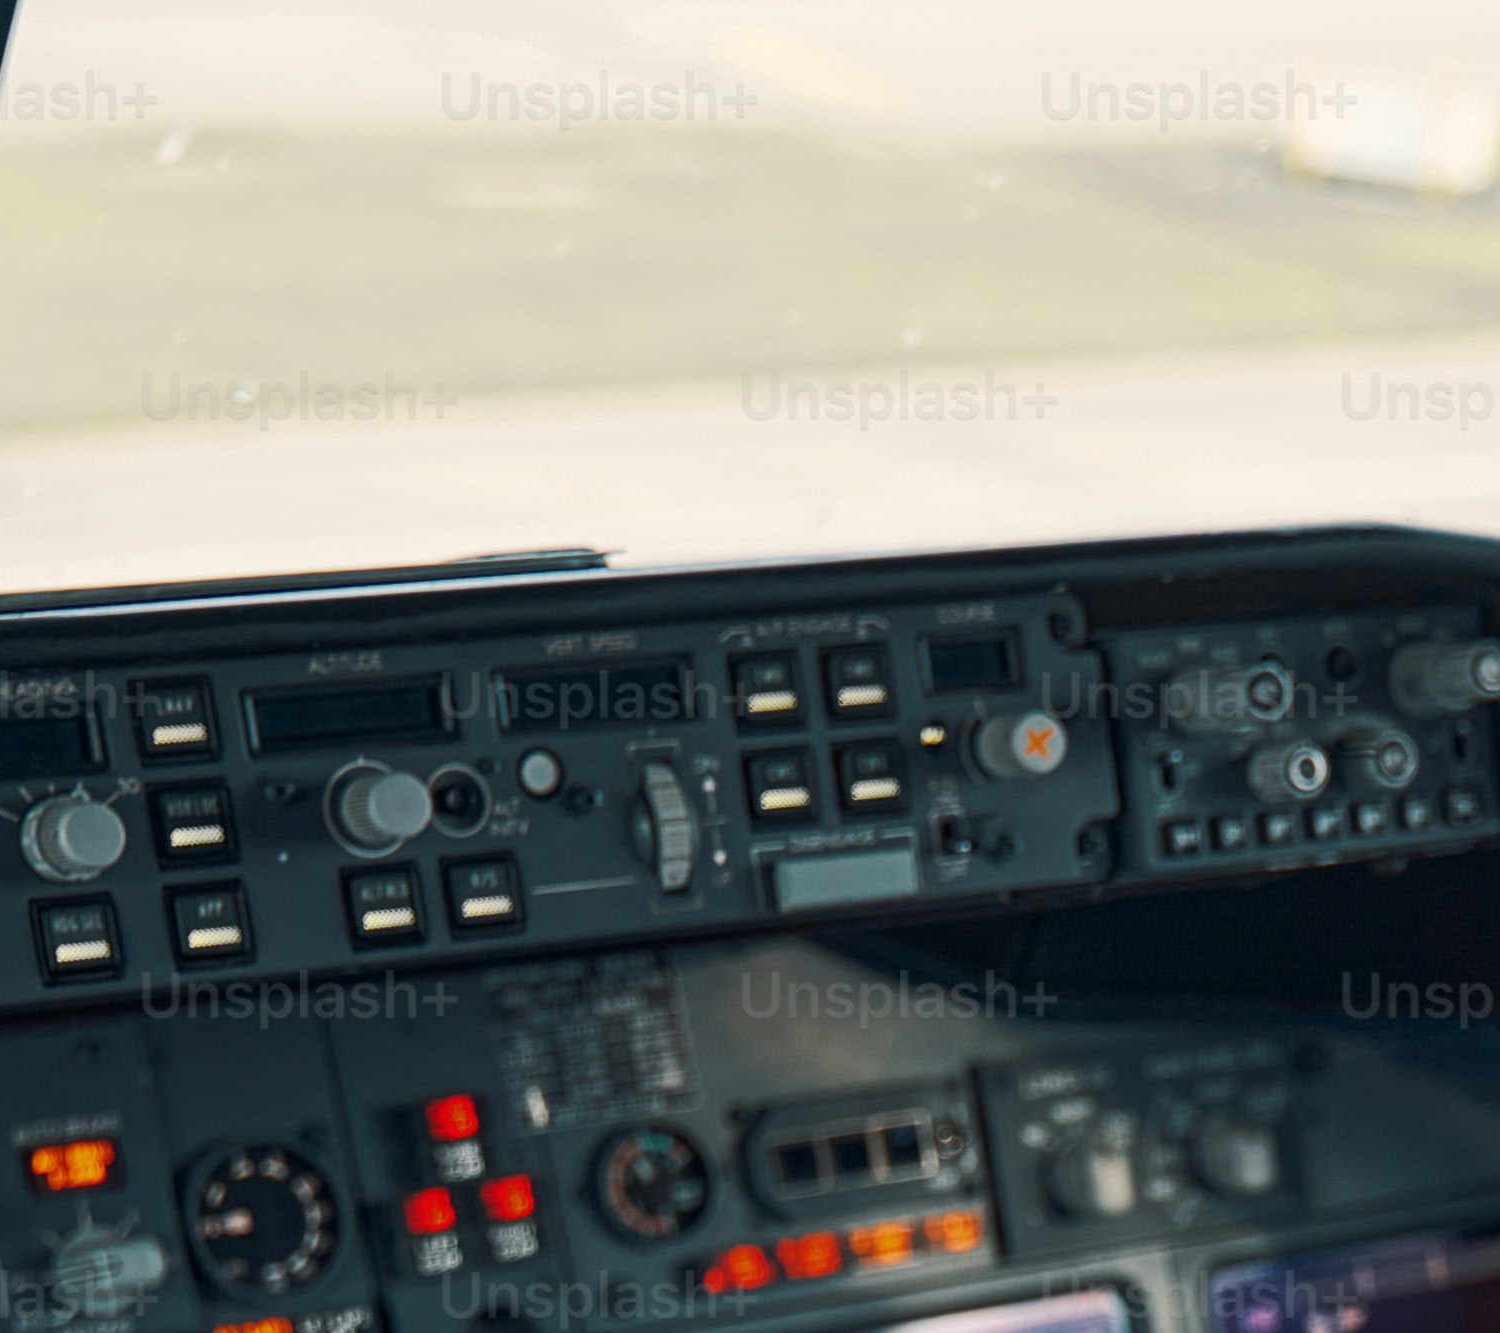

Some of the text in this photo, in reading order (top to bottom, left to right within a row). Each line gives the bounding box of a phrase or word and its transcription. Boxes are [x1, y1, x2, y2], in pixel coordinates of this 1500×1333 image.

[545, 630, 639, 656] VERT SPEED
[308, 650, 384, 676] ALTITUDE
